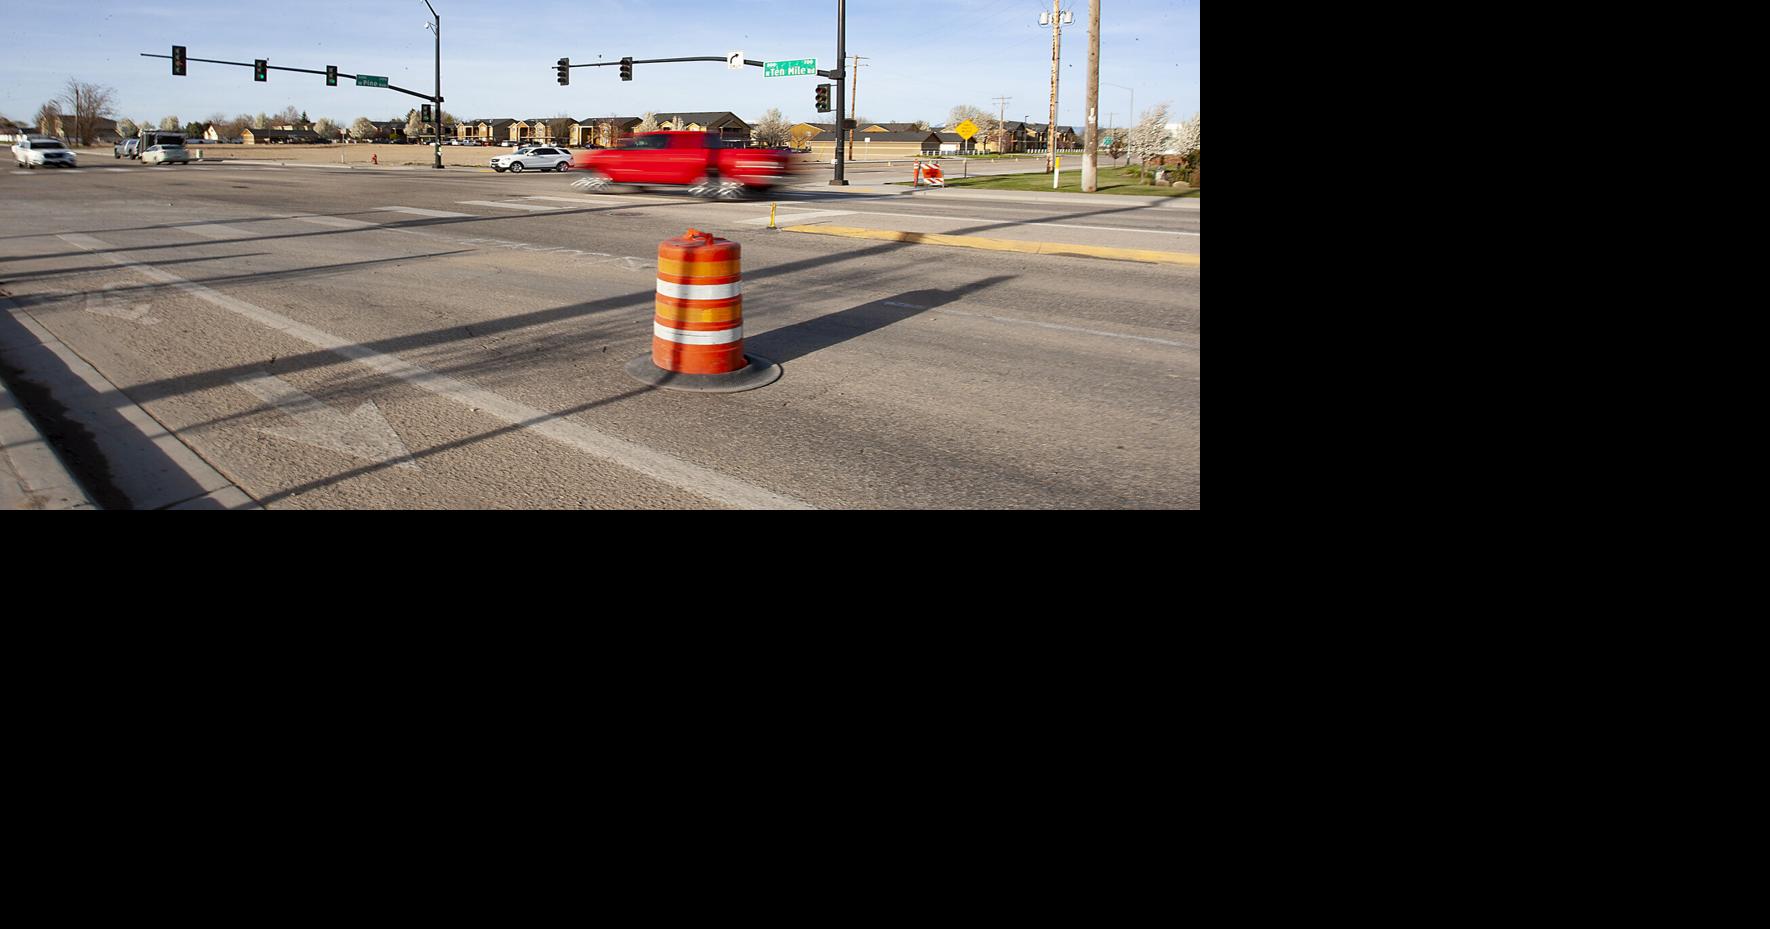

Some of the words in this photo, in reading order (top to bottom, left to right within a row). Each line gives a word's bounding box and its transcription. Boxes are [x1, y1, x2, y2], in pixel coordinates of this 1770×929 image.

[770, 68, 785, 76] Ten
[787, 66, 806, 75] Mile
[363, 79, 378, 87] Pine
